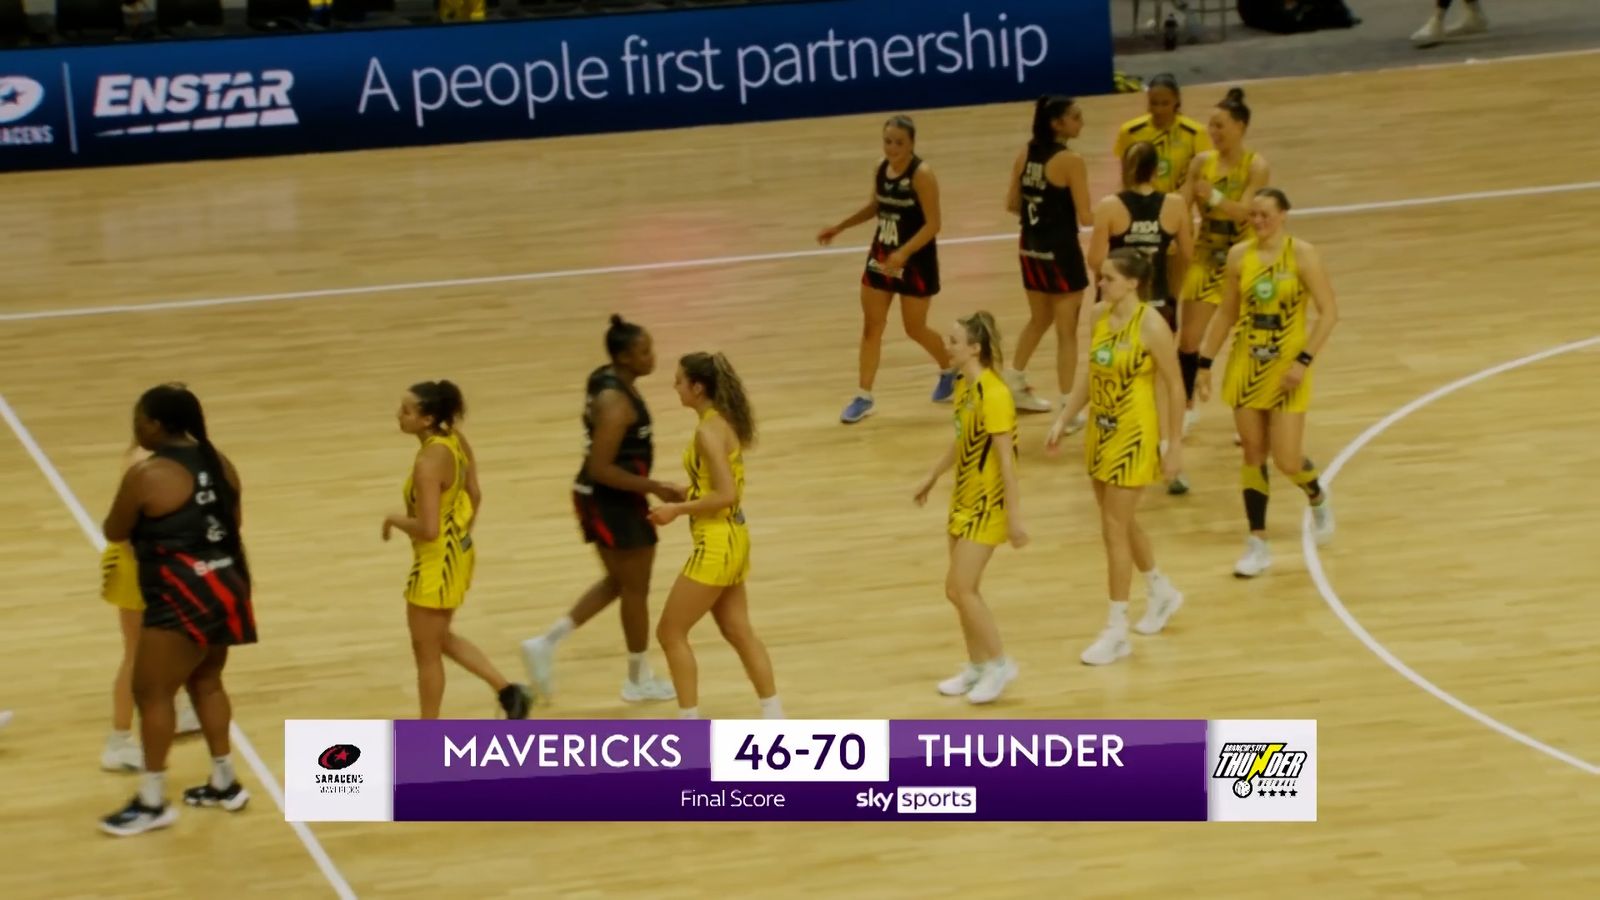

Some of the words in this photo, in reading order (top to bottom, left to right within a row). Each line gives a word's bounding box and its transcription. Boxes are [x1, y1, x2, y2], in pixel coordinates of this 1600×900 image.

[93, 70, 295, 118] ENSTAR
[358, 57, 400, 114] A
[412, 41, 609, 128] people
[620, 34, 725, 96] first
[736, 12, 1048, 104] partnership
[0, 125, 54, 146] ACENS
